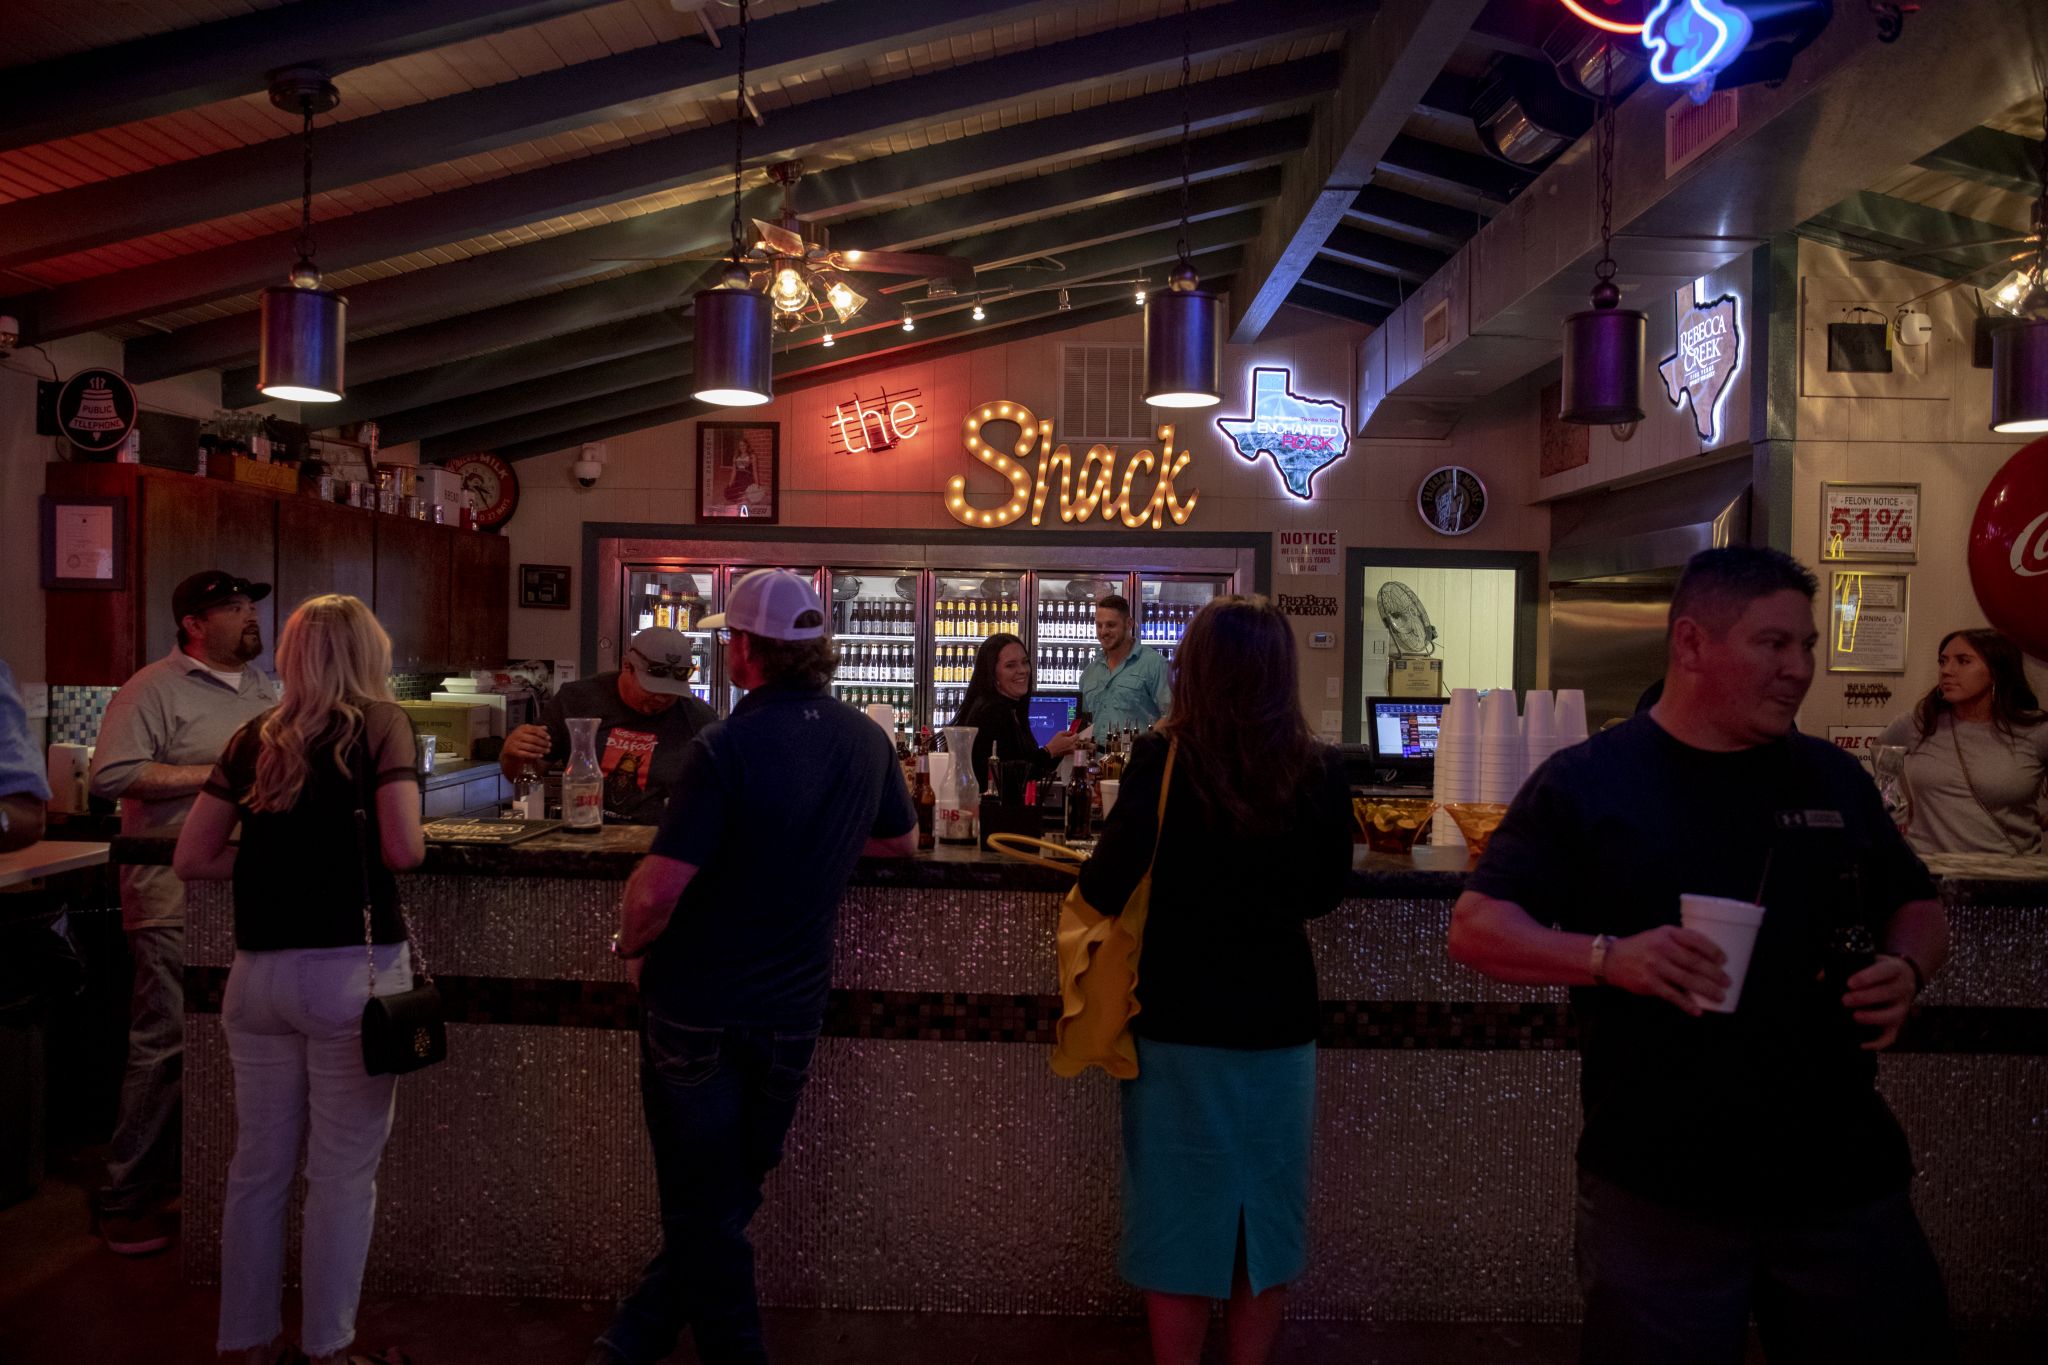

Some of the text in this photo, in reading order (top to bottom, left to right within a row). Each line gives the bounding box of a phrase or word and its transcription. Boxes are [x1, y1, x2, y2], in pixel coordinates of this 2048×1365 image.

[1680, 315, 1727, 356] REBECCA
[1684, 337, 1723, 372] CREEK
[82, 405, 112, 414] PUBLIC
[74, 419, 120, 429] TELEPHONE
[1257, 422, 1339, 436] ENCHANTED
[1282, 434, 1335, 451] ROCK
[480, 452, 510, 480] MILK
[832, 399, 1200, 529] the Shack
[444, 489, 459, 503] BREAD
[1844, 496, 1899, 506] FELONY NOTICE
[1829, 507, 1912, 544] 51%
[1280, 532, 1337, 545] NOTICE
[1835, 736, 1861, 748] FIRE
